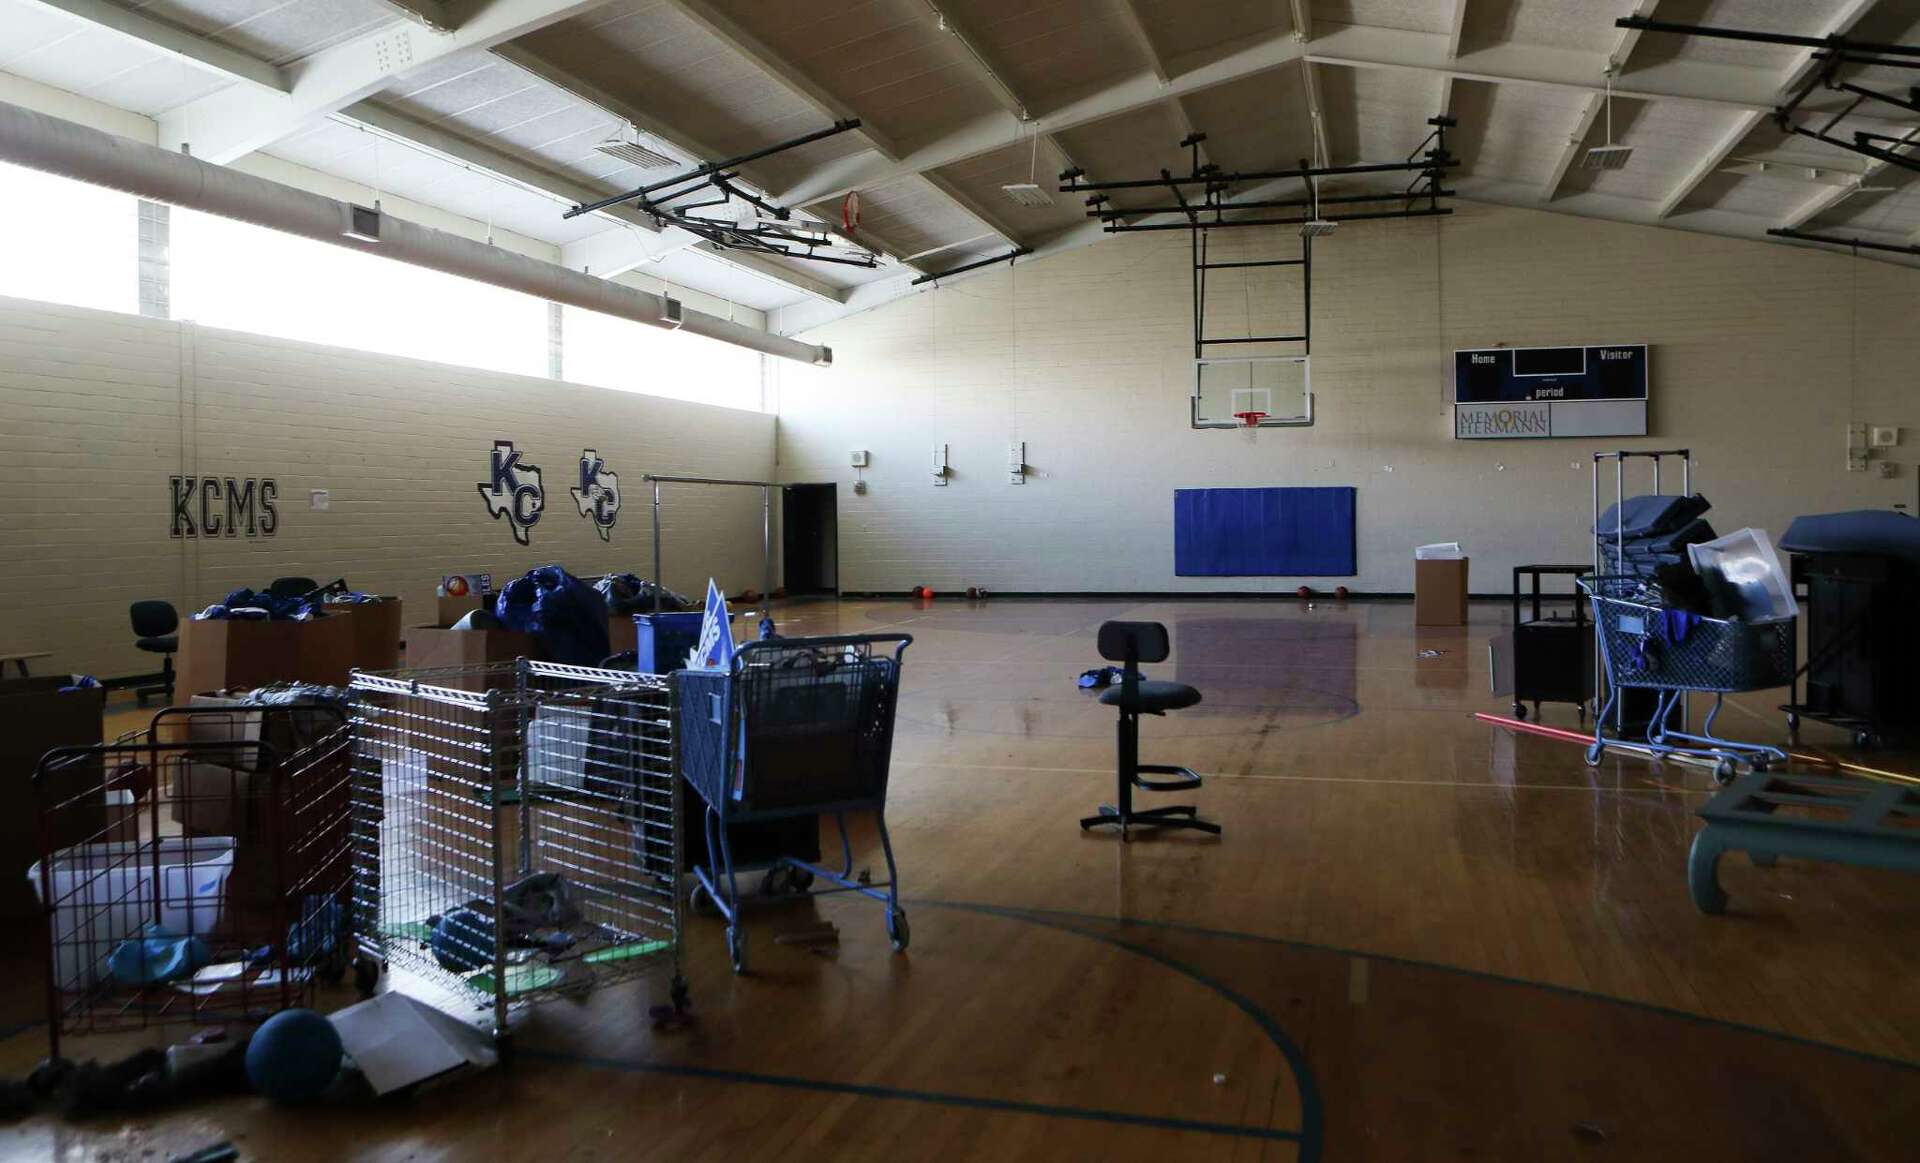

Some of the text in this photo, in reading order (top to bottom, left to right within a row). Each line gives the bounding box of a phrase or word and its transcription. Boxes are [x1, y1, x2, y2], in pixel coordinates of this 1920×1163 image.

[1471, 348, 1634, 364] Home Visitor
[1535, 386, 1564, 399] period
[1460, 409, 1546, 424] MEMORIAL
[1460, 421, 1546, 434] HERMANN
[168, 475, 279, 539] KCMS
